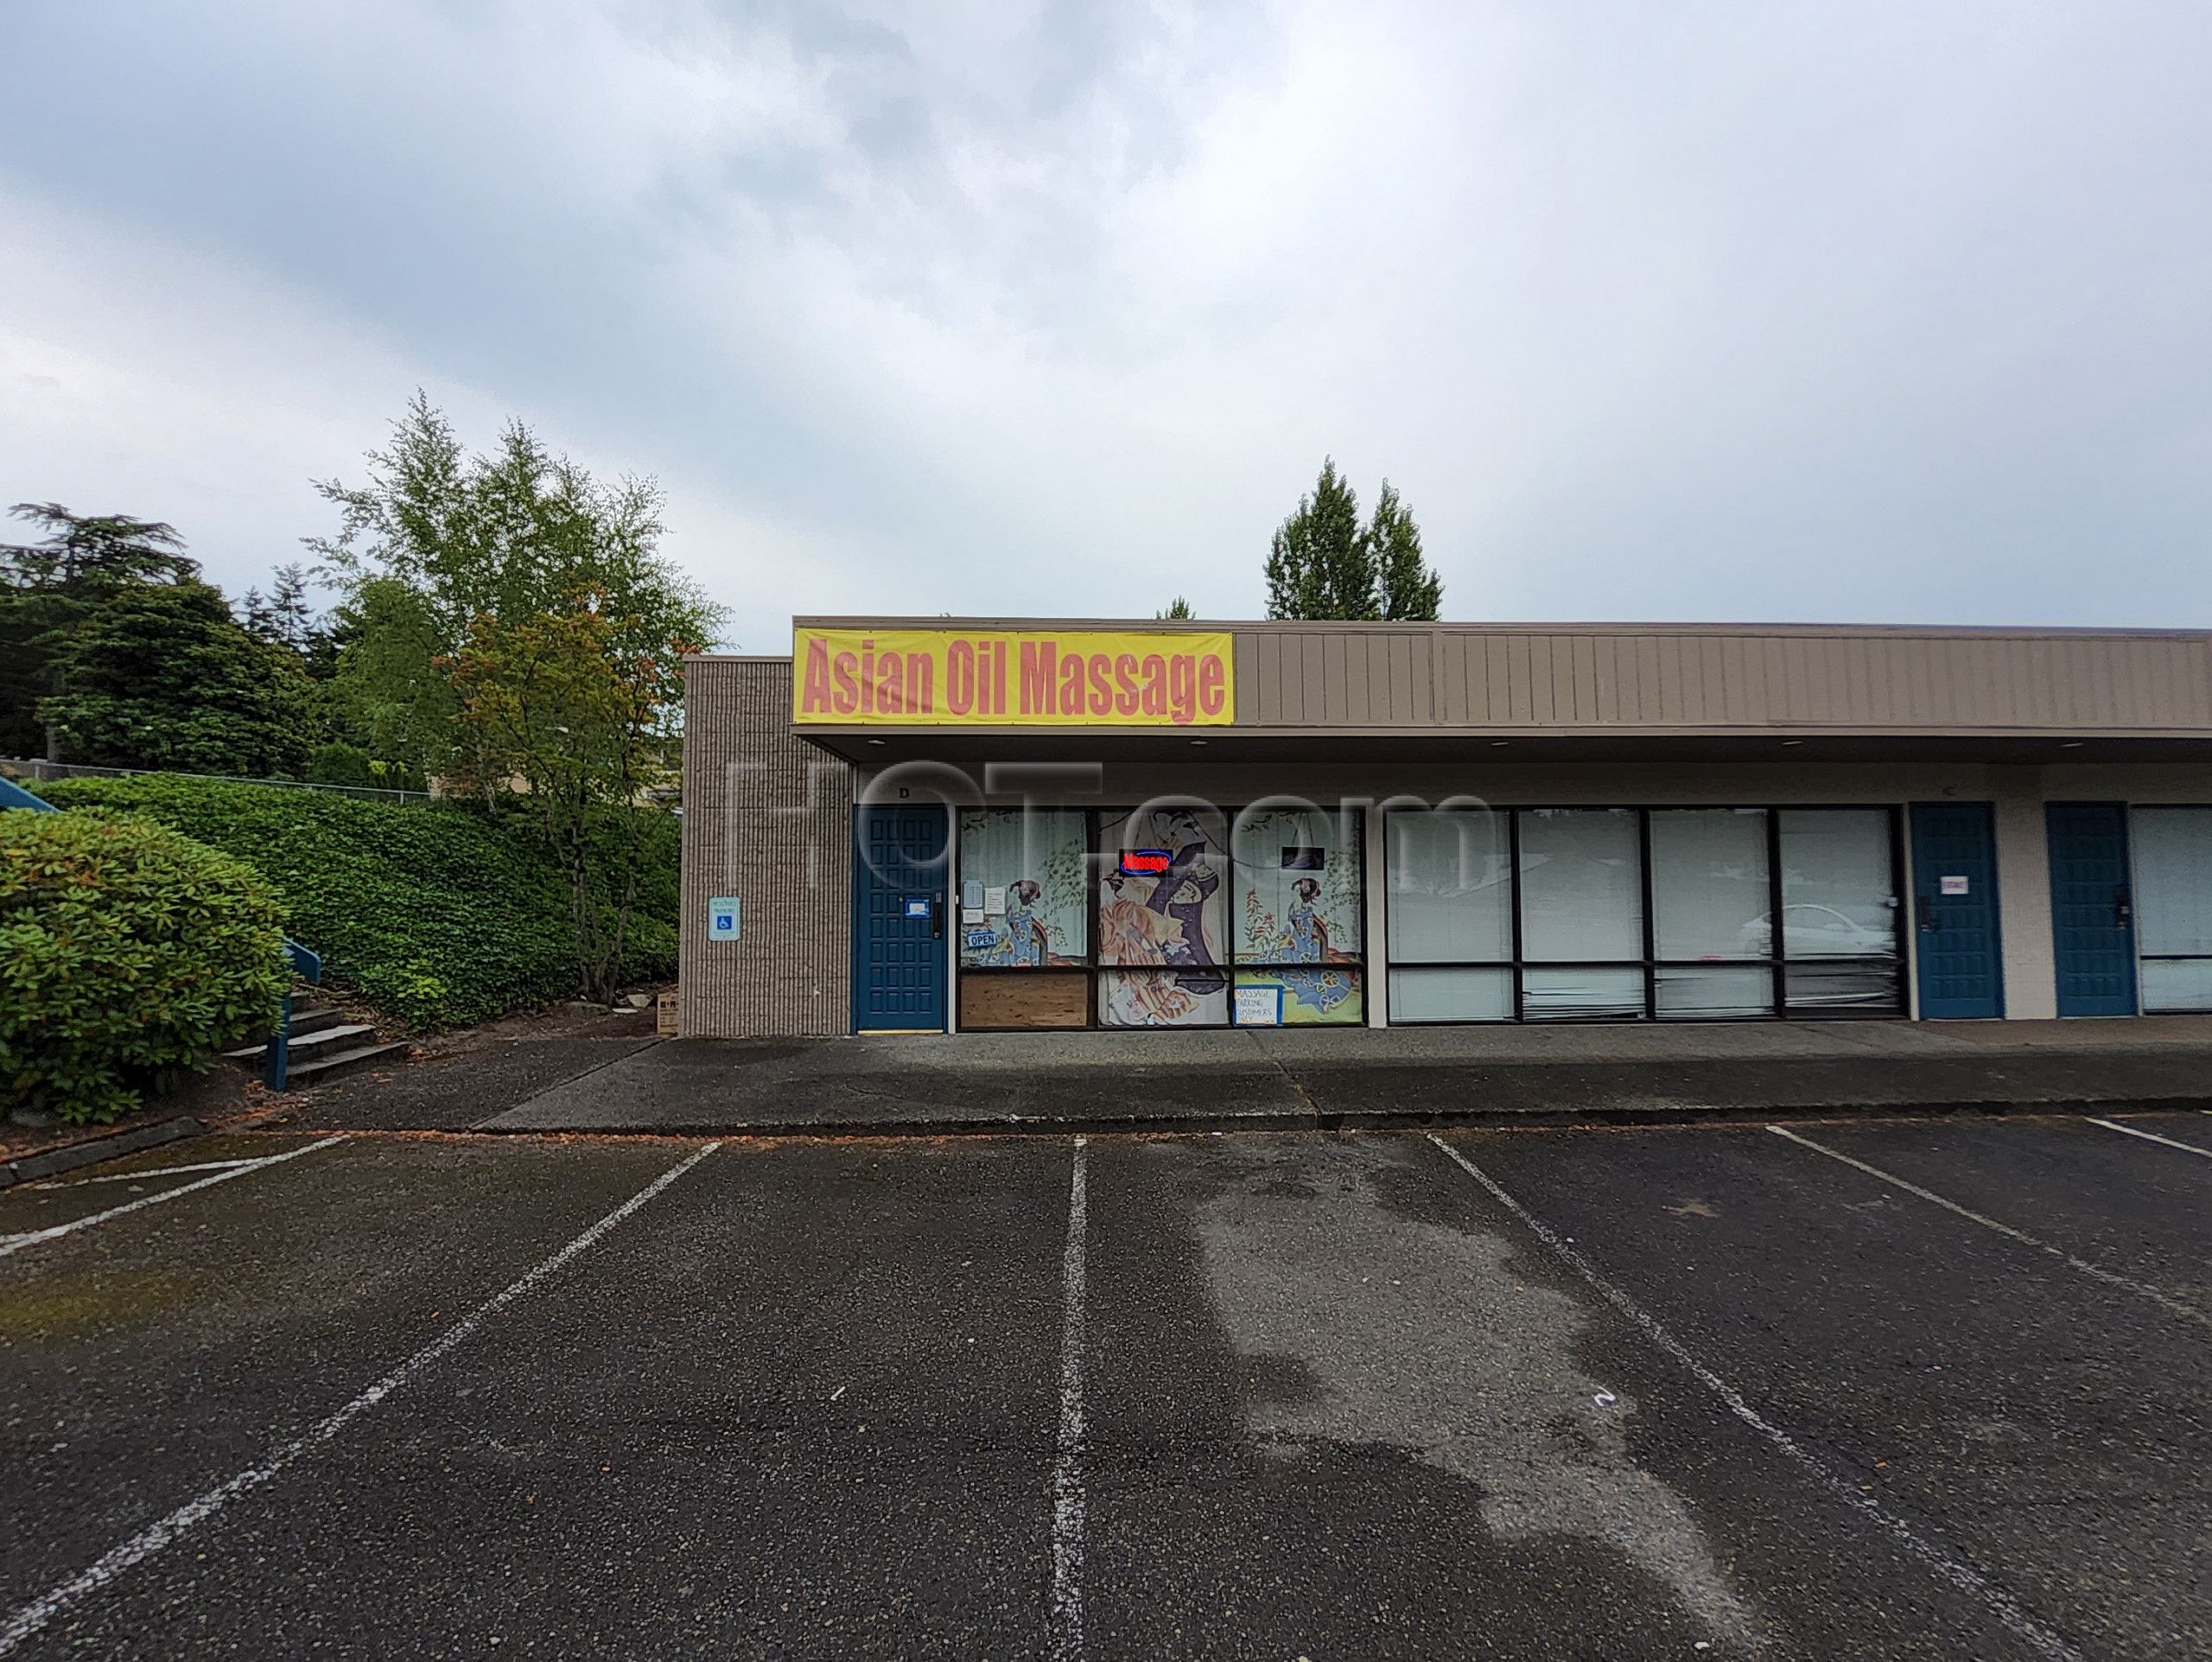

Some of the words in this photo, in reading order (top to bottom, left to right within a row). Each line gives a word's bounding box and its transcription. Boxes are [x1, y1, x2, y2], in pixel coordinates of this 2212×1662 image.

[801, 638, 933, 714] Asian
[947, 639, 1007, 716] Oil
[1019, 640, 1226, 726] Massage
[899, 787, 909, 799] D
[1123, 852, 1169, 873] Massage
[971, 935, 995, 946] OPEN
